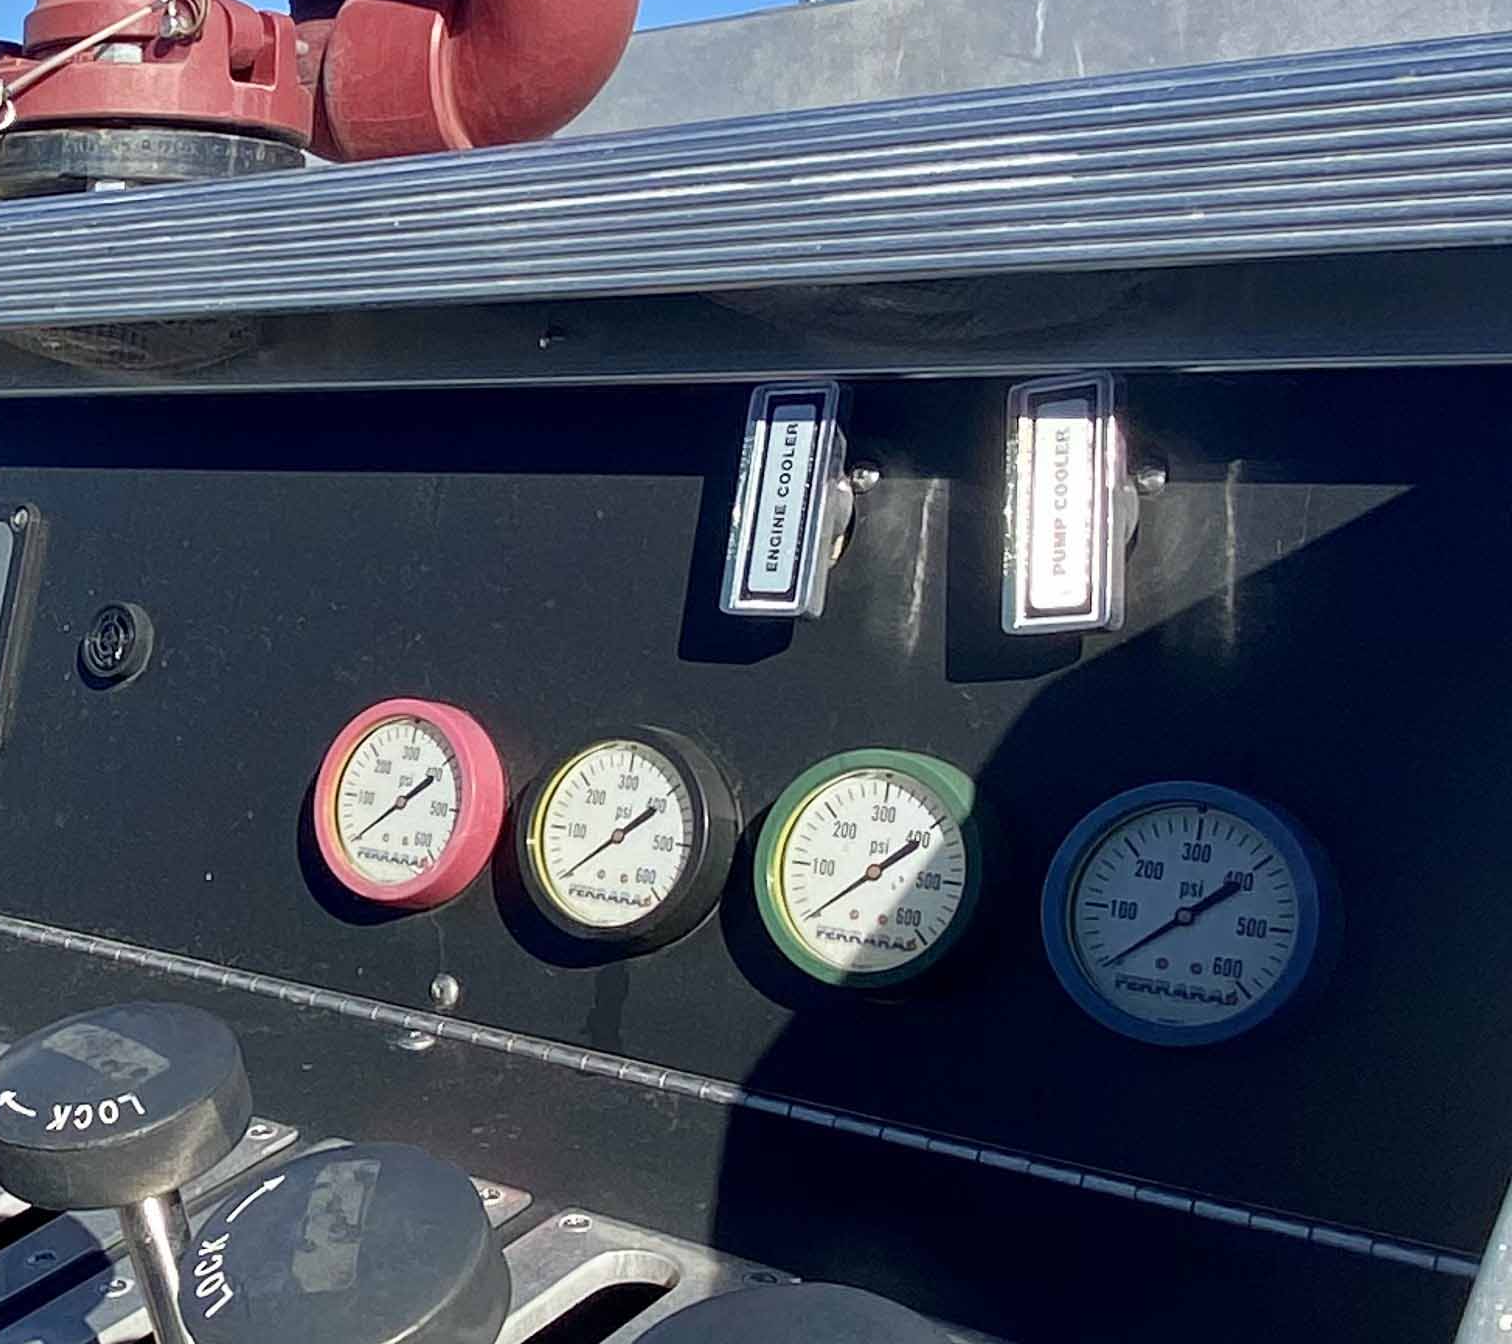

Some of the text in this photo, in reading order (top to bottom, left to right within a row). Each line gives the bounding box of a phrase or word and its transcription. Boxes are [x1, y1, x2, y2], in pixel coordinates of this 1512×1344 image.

[765, 421, 800, 573] ENGINE COOLER
[1051, 425, 1072, 577] PUMP COOLER
[402, 745, 421, 762] 300
[374, 759, 393, 775] 200
[399, 774, 413, 788] psi
[617, 774, 639, 791] 300
[359, 789, 376, 806] 100
[586, 788, 606, 806] 200
[430, 801, 449, 817] 500
[615, 805, 633, 822] psi
[871, 804, 896, 824] 300
[414, 831, 433, 848] 600
[567, 823, 587, 840] 100
[831, 820, 857, 840] 200
[652, 835, 674, 853] 500
[869, 838, 889, 857] psi
[1181, 842, 1212, 864] 300
[635, 867, 657, 885] 600
[812, 859, 835, 877] 100
[1134, 859, 1165, 881] 200
[916, 871, 941, 890] 500
[1178, 879, 1204, 900] psi
[895, 908, 922, 927] 600
[1110, 899, 1138, 921] 100
[1236, 917, 1268, 939] 500
[1212, 955, 1244, 979] 600
[45, 1092, 146, 1133] LOCK
[193, 1232, 234, 1319] LOCK
